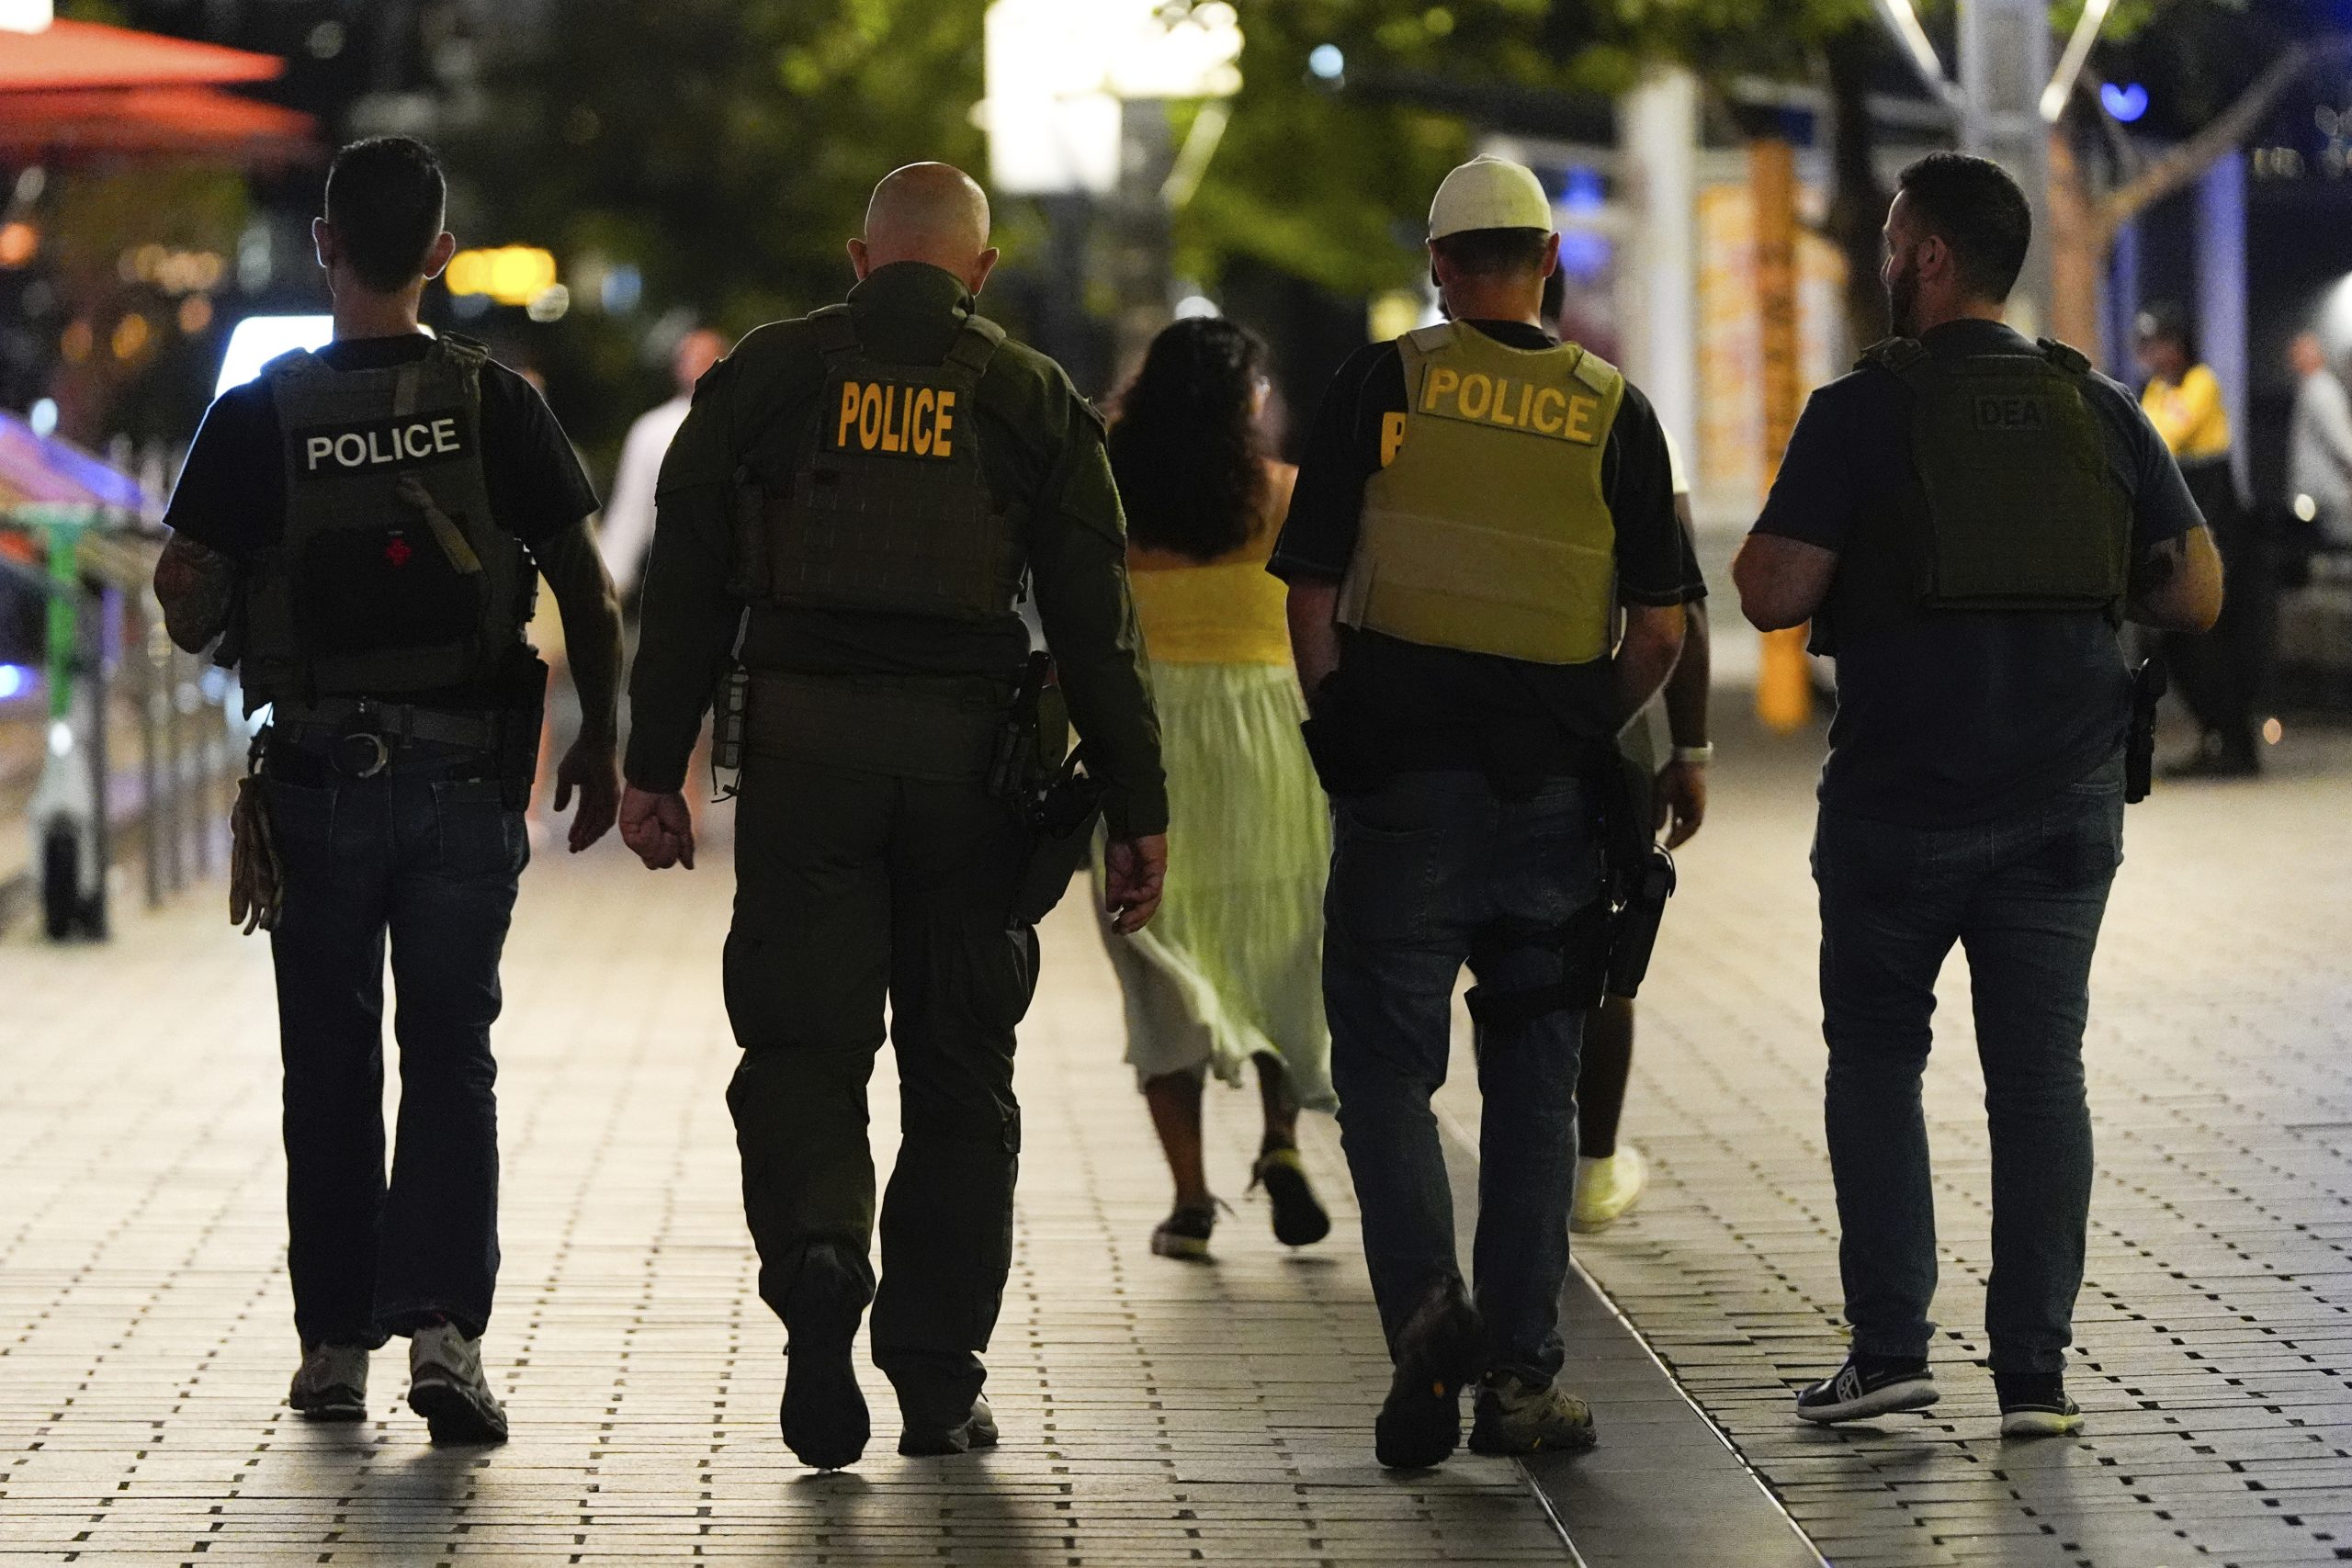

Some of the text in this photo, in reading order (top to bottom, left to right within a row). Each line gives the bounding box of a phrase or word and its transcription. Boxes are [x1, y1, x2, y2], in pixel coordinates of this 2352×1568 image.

[837, 381, 956, 457] POLICE
[1425, 367, 1598, 442] POLICE
[1980, 398, 2042, 425] DEA
[306, 418, 461, 470] POLICE
